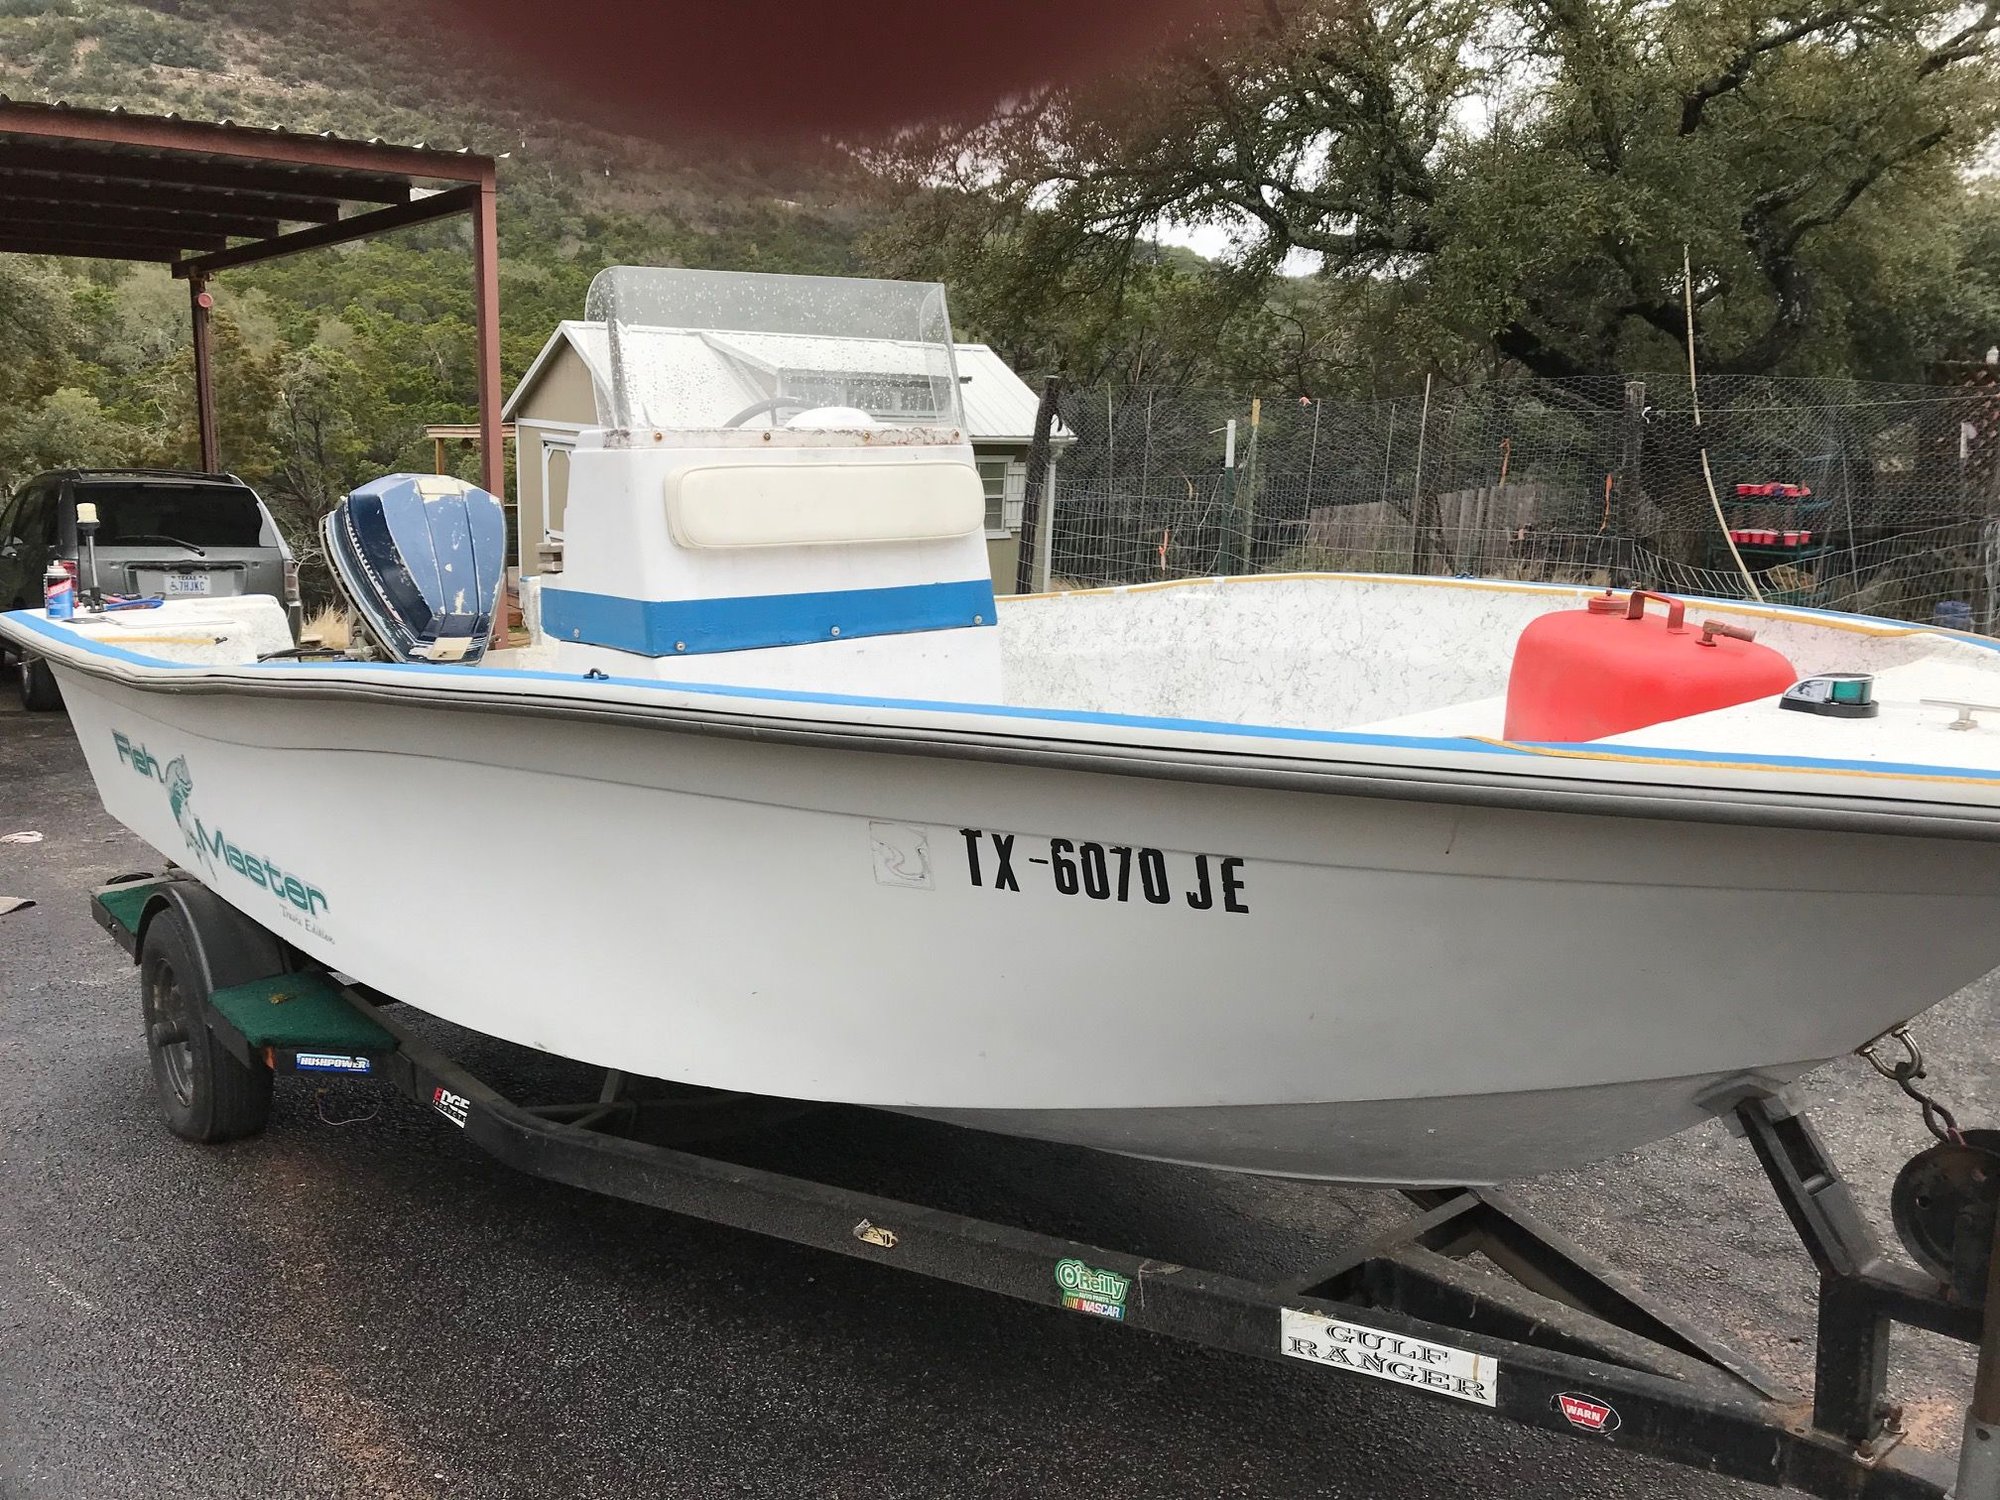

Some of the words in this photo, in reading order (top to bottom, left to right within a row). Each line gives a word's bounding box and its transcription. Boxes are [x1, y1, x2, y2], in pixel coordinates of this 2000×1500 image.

[112, 730, 164, 784] Fish
[195, 817, 329, 916] Master
[959, 828, 1020, 892] TX
[1186, 854, 1250, 914] JE
[300, 1057, 366, 1069] HUSHPOWER
[1287, 1335, 1488, 1400] RANGER
[1324, 1323, 1448, 1364] GULF
[1566, 1404, 1601, 1422] WARN
